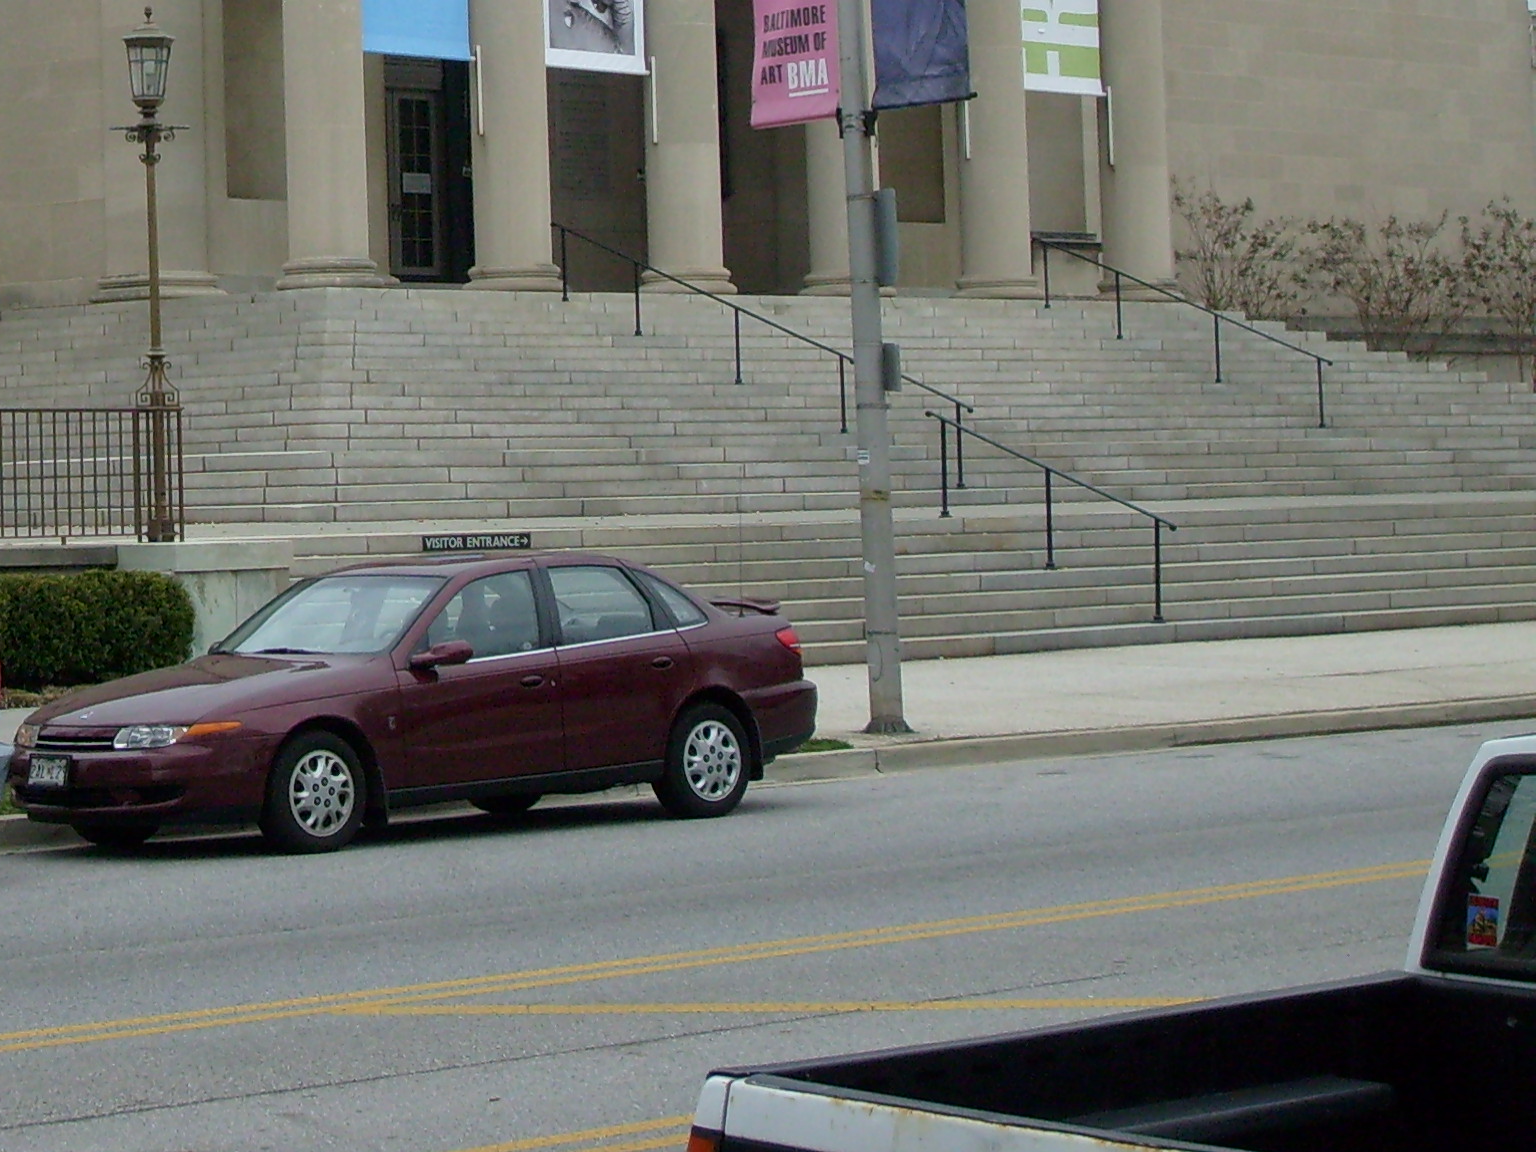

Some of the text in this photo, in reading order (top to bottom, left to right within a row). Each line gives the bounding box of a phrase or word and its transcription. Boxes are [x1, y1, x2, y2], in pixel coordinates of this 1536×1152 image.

[763, 4, 826, 34] BALTIMORE
[762, 31, 827, 59] MUSEUM OF
[760, 58, 829, 90] ART BMA
[425, 534, 520, 549] VISITOR ENTRANCE
